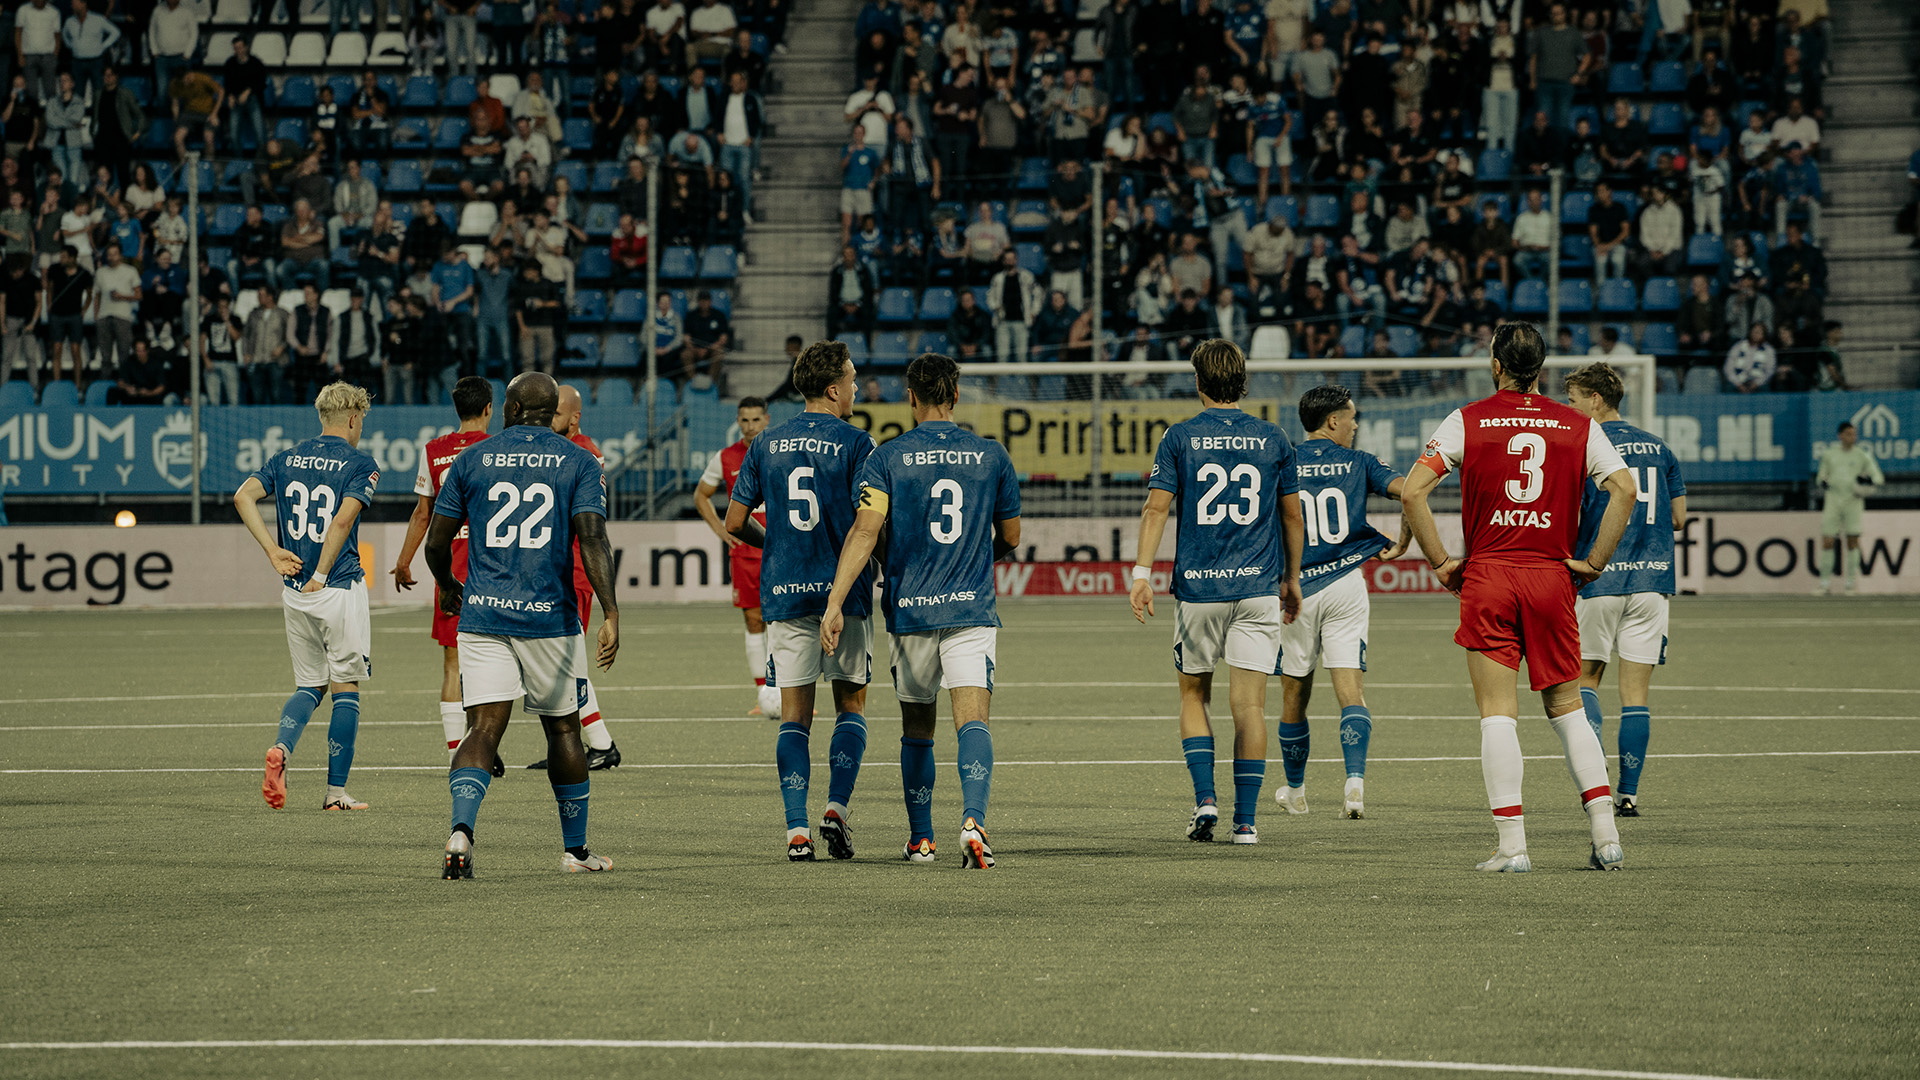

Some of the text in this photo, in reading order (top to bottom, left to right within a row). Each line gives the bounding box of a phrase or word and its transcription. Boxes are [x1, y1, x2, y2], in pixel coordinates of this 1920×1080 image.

[779, 437, 844, 457] BETCITY
[1202, 436, 1267, 450] BETCITY
[1614, 442, 1661, 457] ETCITY
[291, 455, 349, 472] BETCITY
[494, 453, 566, 468] BETCITY
[915, 449, 985, 465] BETCITY
[1504, 432, 1547, 504] 3
[788, 466, 820, 532] 5
[1197, 463, 1262, 526] 23
[285, 480, 336, 544] 33
[486, 481, 555, 549] 22
[930, 478, 964, 545] 3
[1299, 487, 1350, 547] 10
[1489, 509, 1552, 529] AKTAS
[0, 543, 174, 606] tage
[1203, 568, 1236, 579] THAT
[1305, 561, 1338, 577] THAT
[1340, 553, 1363, 567] ASS
[1616, 561, 1645, 571] THAT
[788, 582, 824, 594] THAT
[1056, 566, 1115, 593] Van
[486, 596, 523, 611] THAT
[915, 593, 948, 607] THAT
